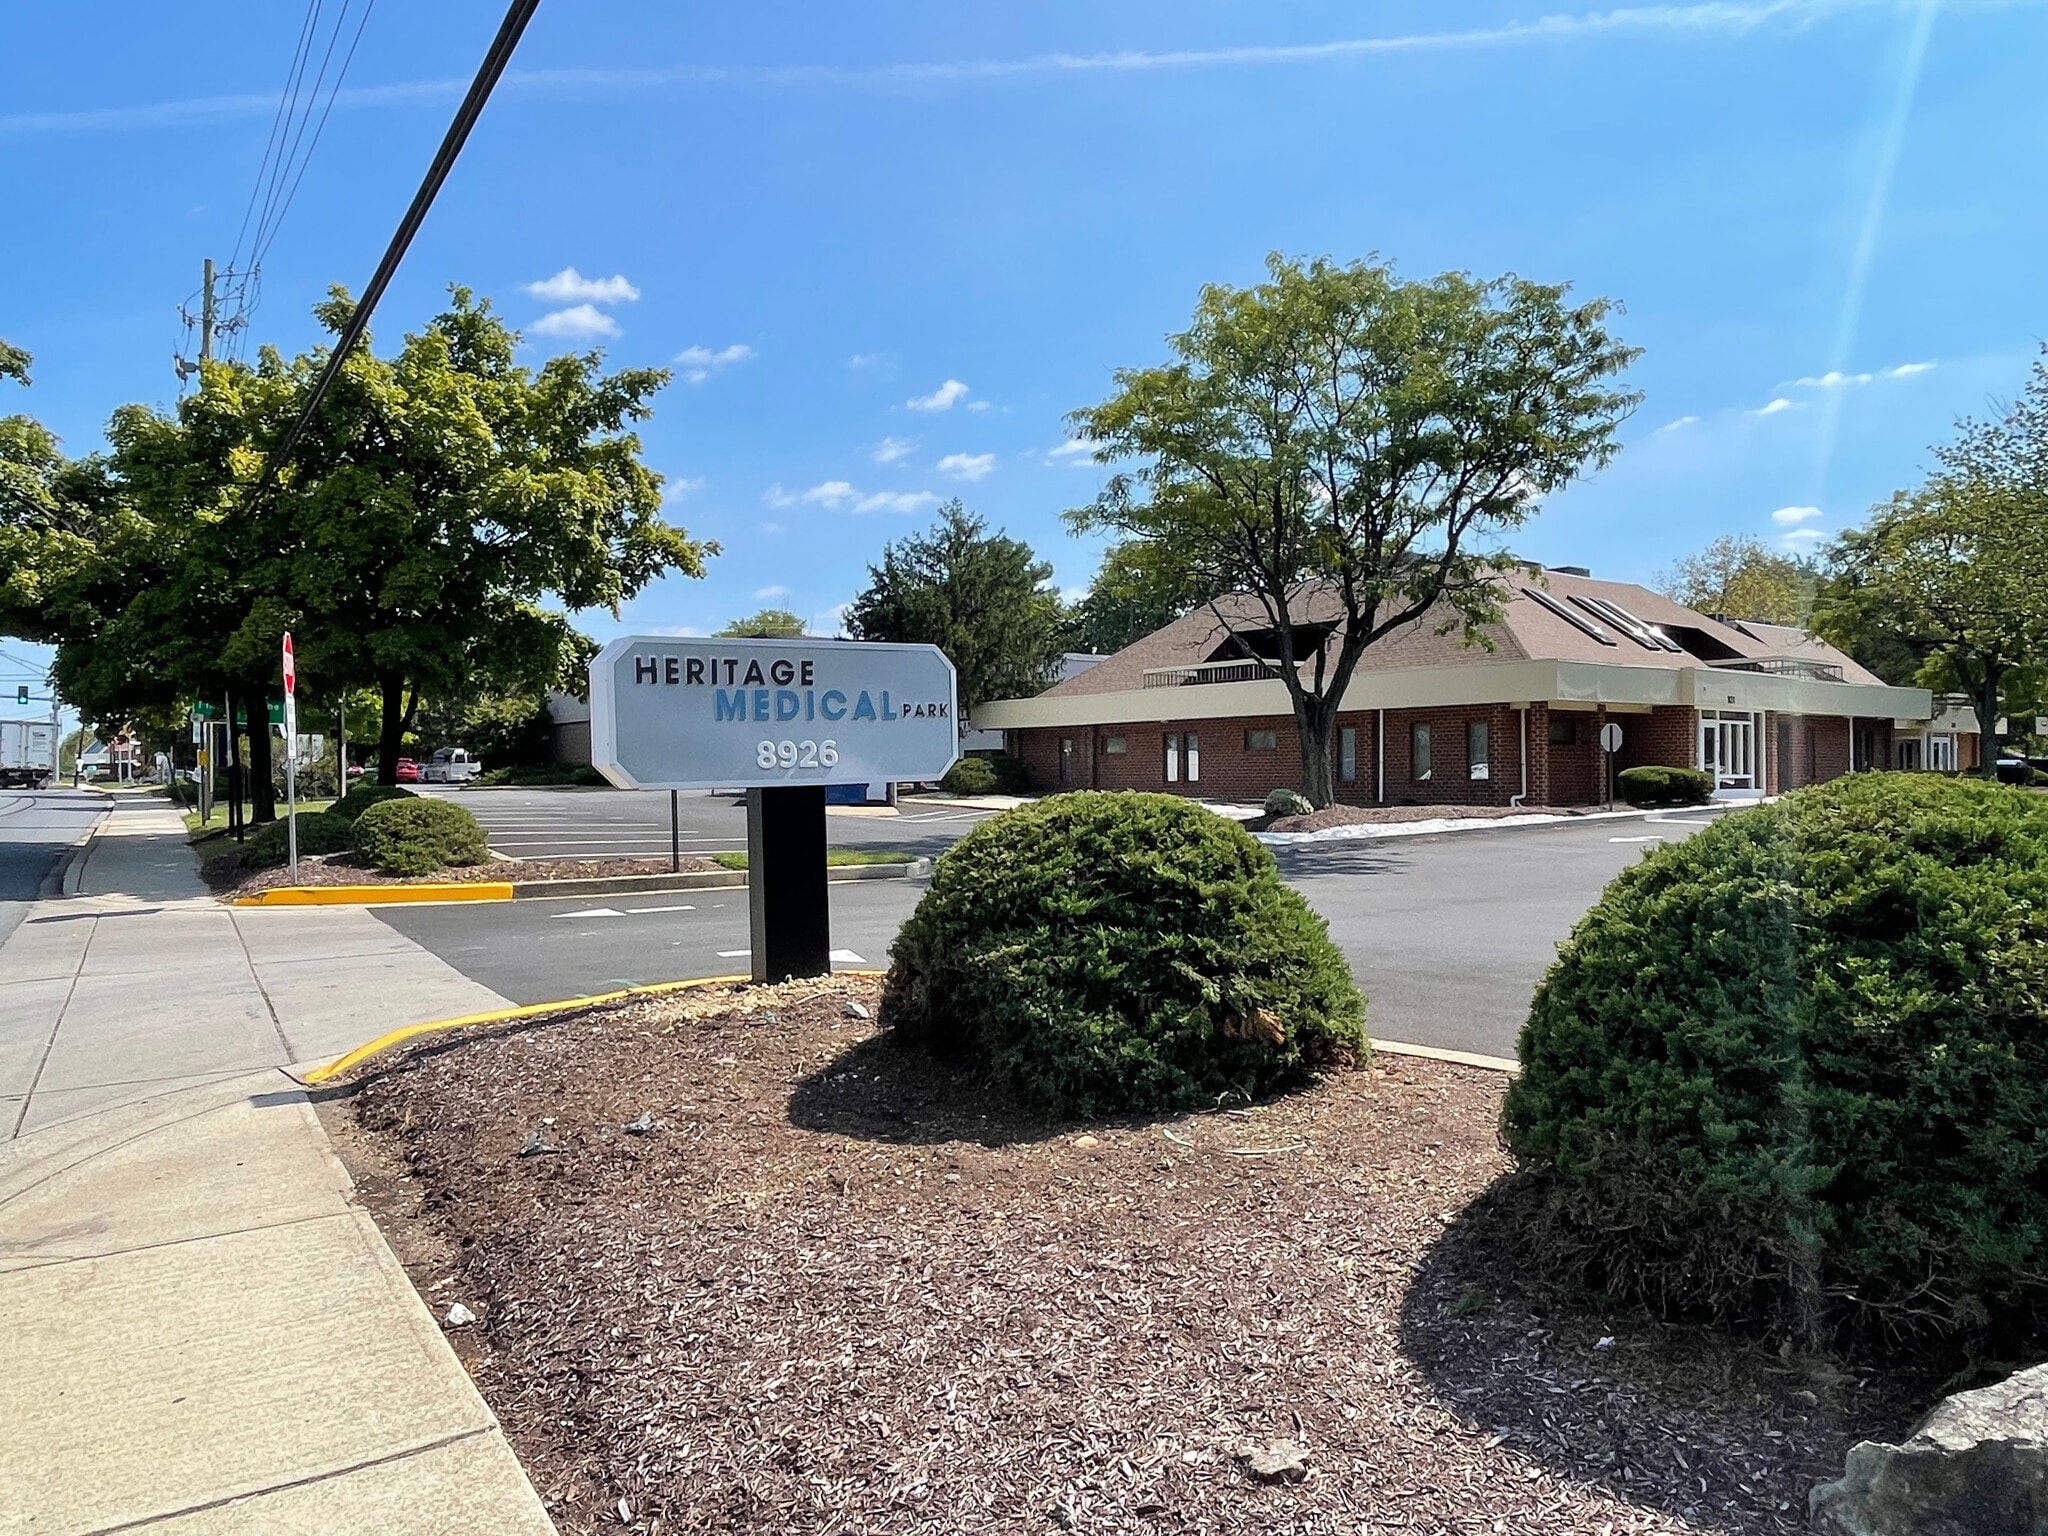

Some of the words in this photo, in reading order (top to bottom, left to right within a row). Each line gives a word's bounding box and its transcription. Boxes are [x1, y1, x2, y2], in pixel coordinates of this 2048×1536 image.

[634, 656, 814, 687] HERITAGE
[714, 688, 898, 722] MEDICAL
[902, 702, 949, 719] PARK
[756, 738, 840, 770] 8926
